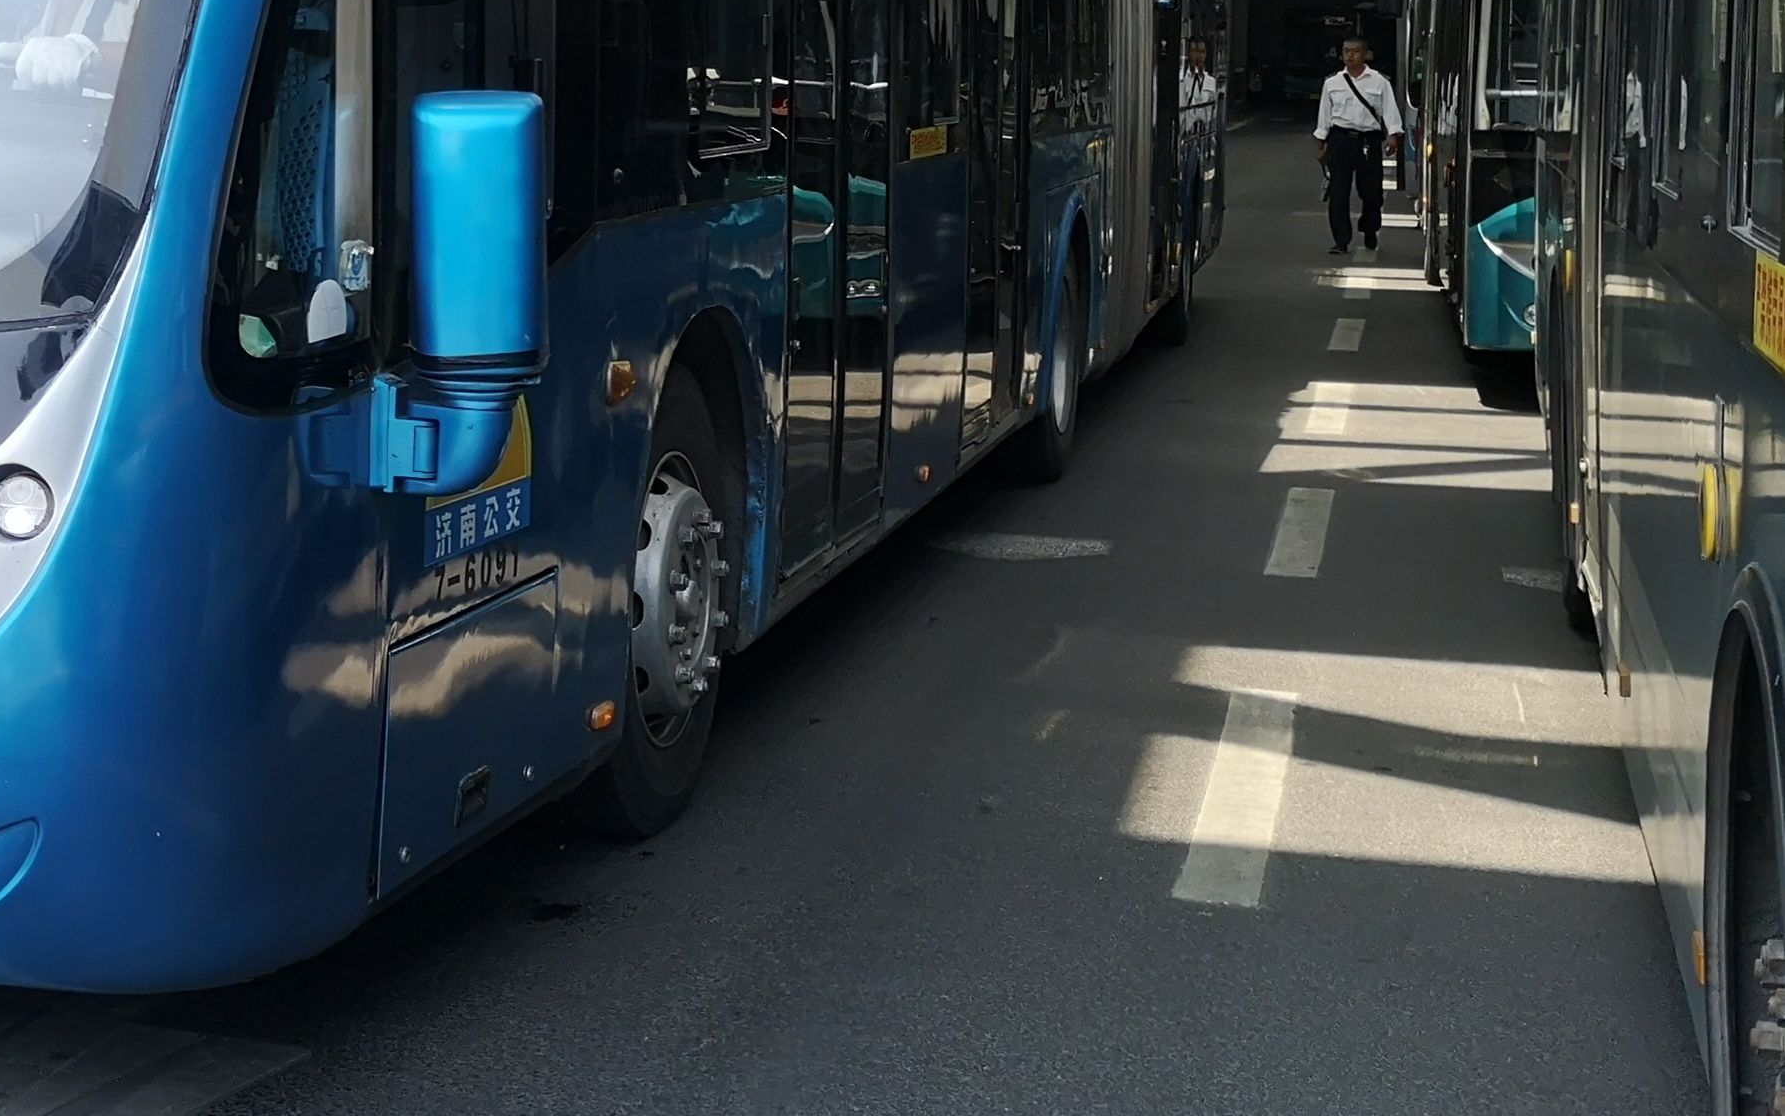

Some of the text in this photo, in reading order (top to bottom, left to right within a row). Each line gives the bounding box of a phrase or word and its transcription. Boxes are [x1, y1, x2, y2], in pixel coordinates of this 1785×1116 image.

[435, 487, 521, 559] 济南公交
[434, 548, 519, 602] 7-6091
